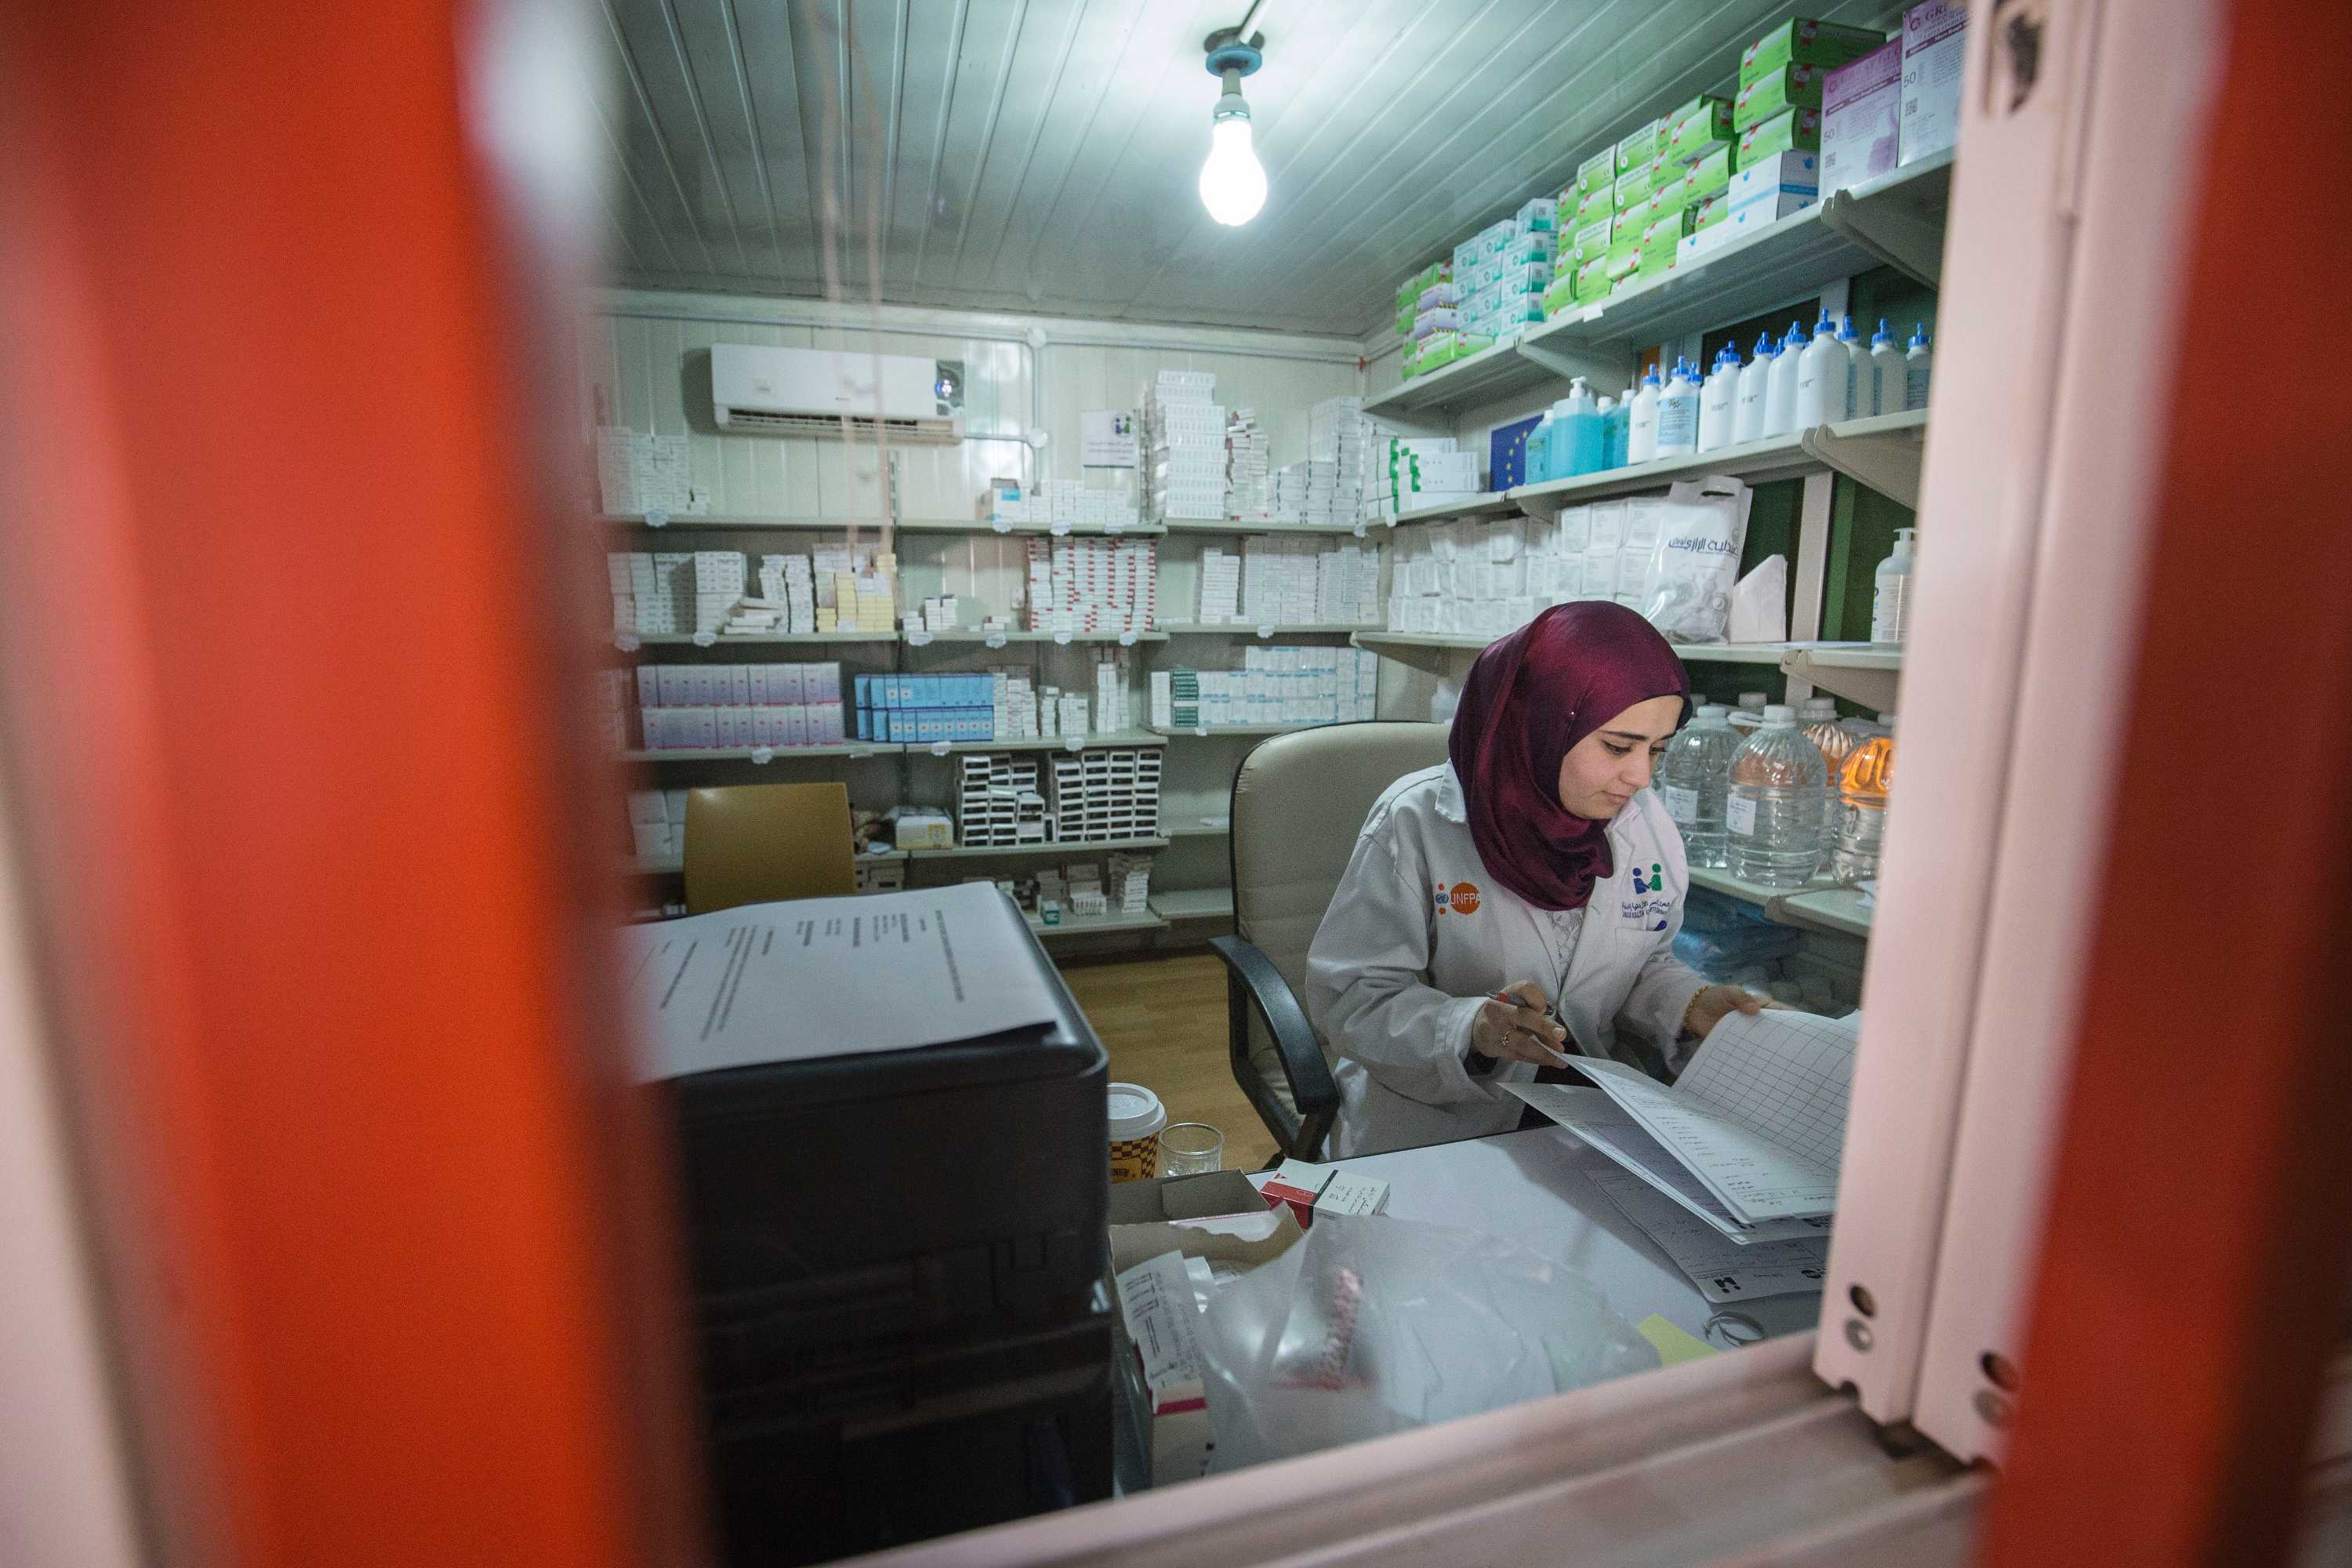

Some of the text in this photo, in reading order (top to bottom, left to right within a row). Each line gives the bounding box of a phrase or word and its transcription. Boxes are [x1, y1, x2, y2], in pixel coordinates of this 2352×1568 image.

[1903, 71, 1917, 89] 50
[1824, 128, 1835, 143] 50
[1450, 893, 1481, 905] UNFPA
